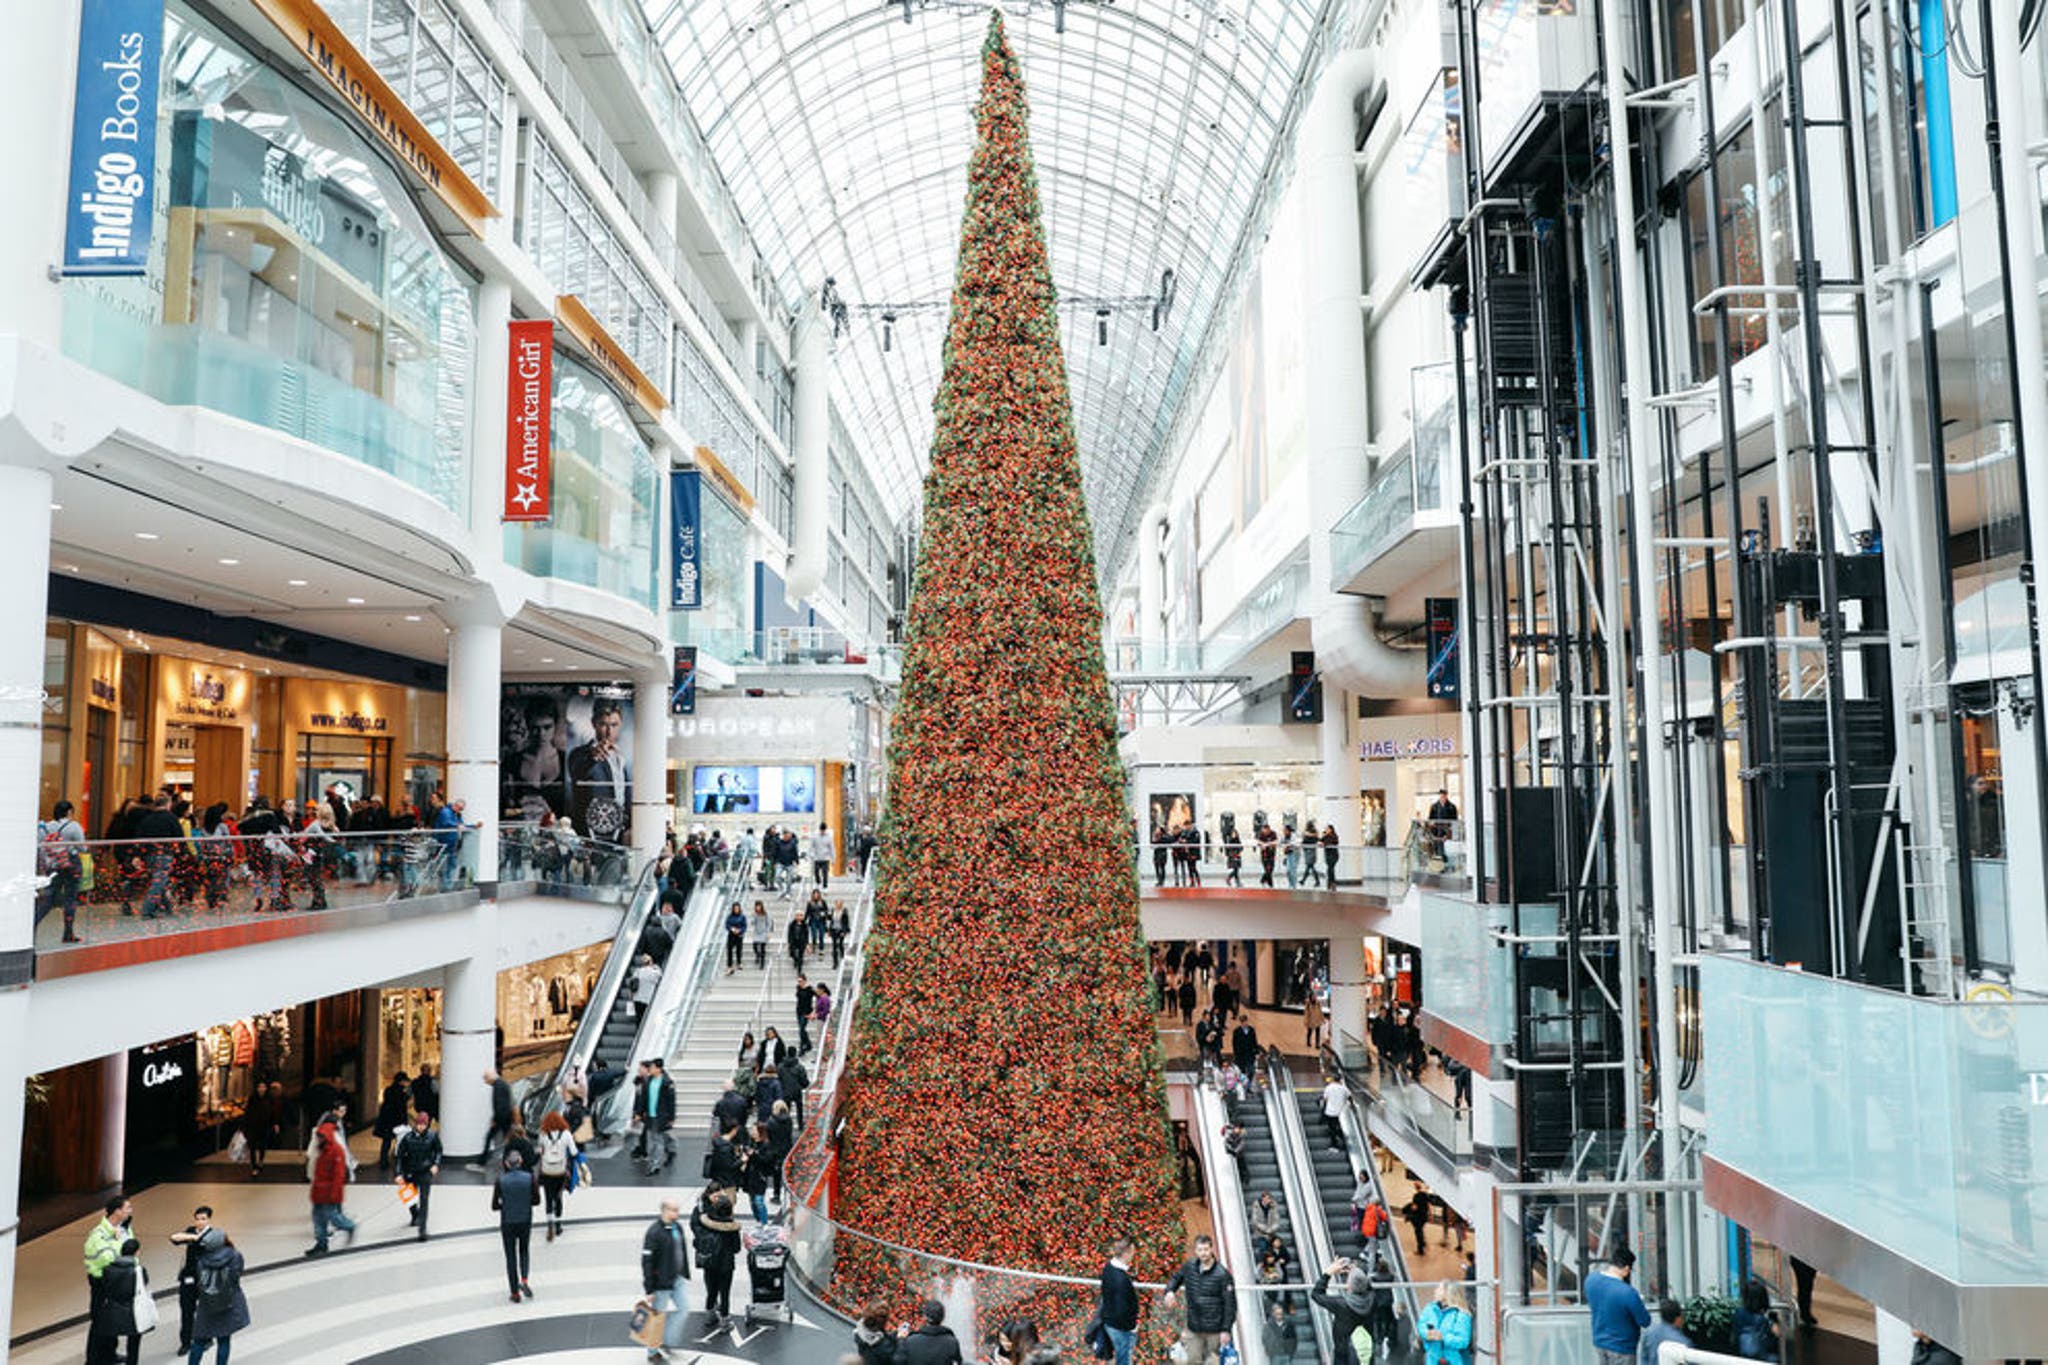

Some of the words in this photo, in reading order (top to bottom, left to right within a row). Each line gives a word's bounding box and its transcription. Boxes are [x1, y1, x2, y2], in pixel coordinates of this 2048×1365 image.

[102, 32, 144, 143] Books
[306, 29, 442, 188] IMAGINATION
[517, 338, 541, 380] Girl
[516, 380, 540, 480] American
